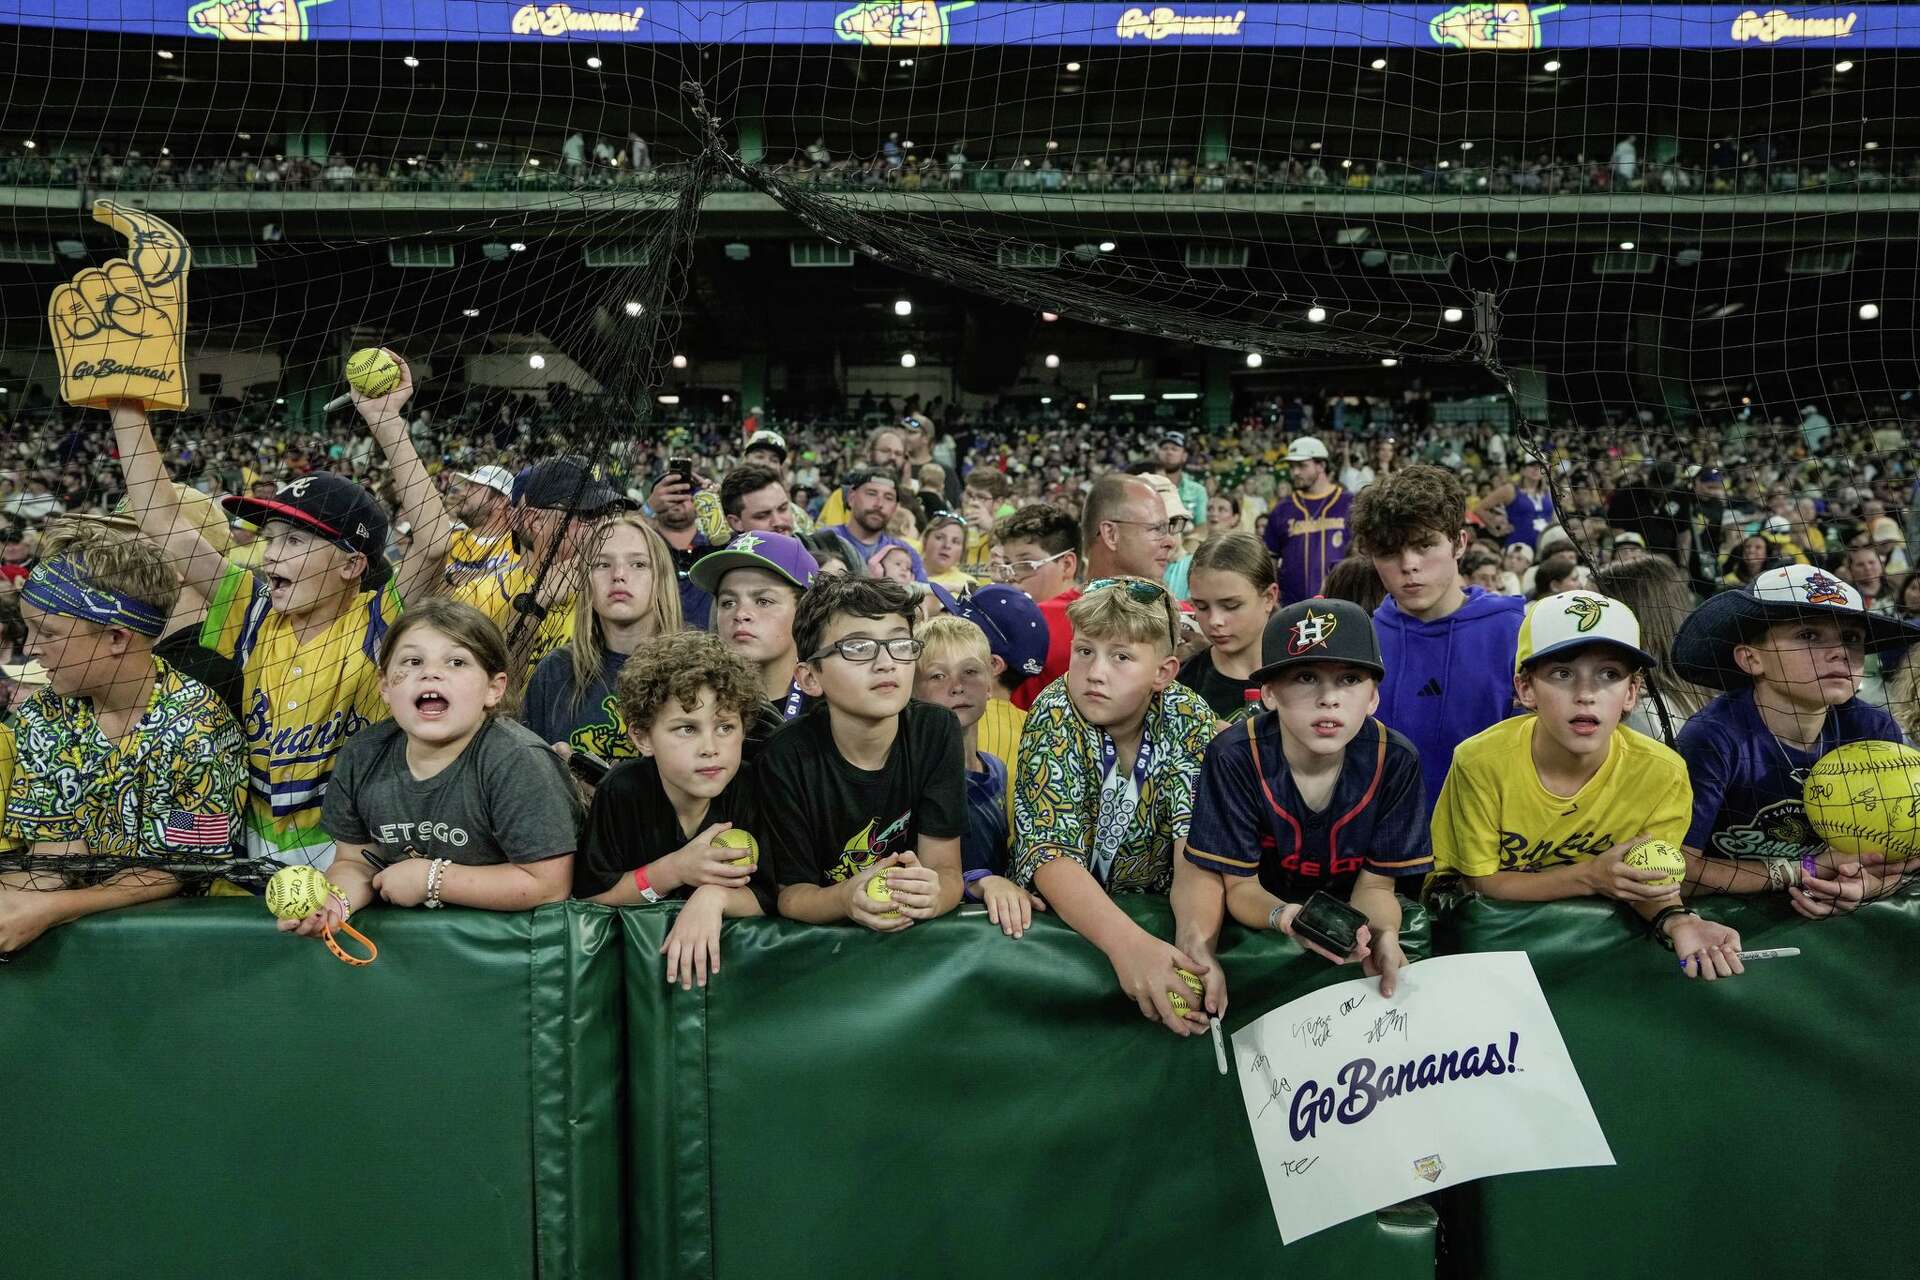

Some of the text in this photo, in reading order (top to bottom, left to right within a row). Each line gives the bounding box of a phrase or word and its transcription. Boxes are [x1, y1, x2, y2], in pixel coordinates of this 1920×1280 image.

[72, 359, 175, 383] Go Bananas!
[1289, 1079, 1336, 1142] Go
[1336, 1031, 1520, 1125] Bananas!
